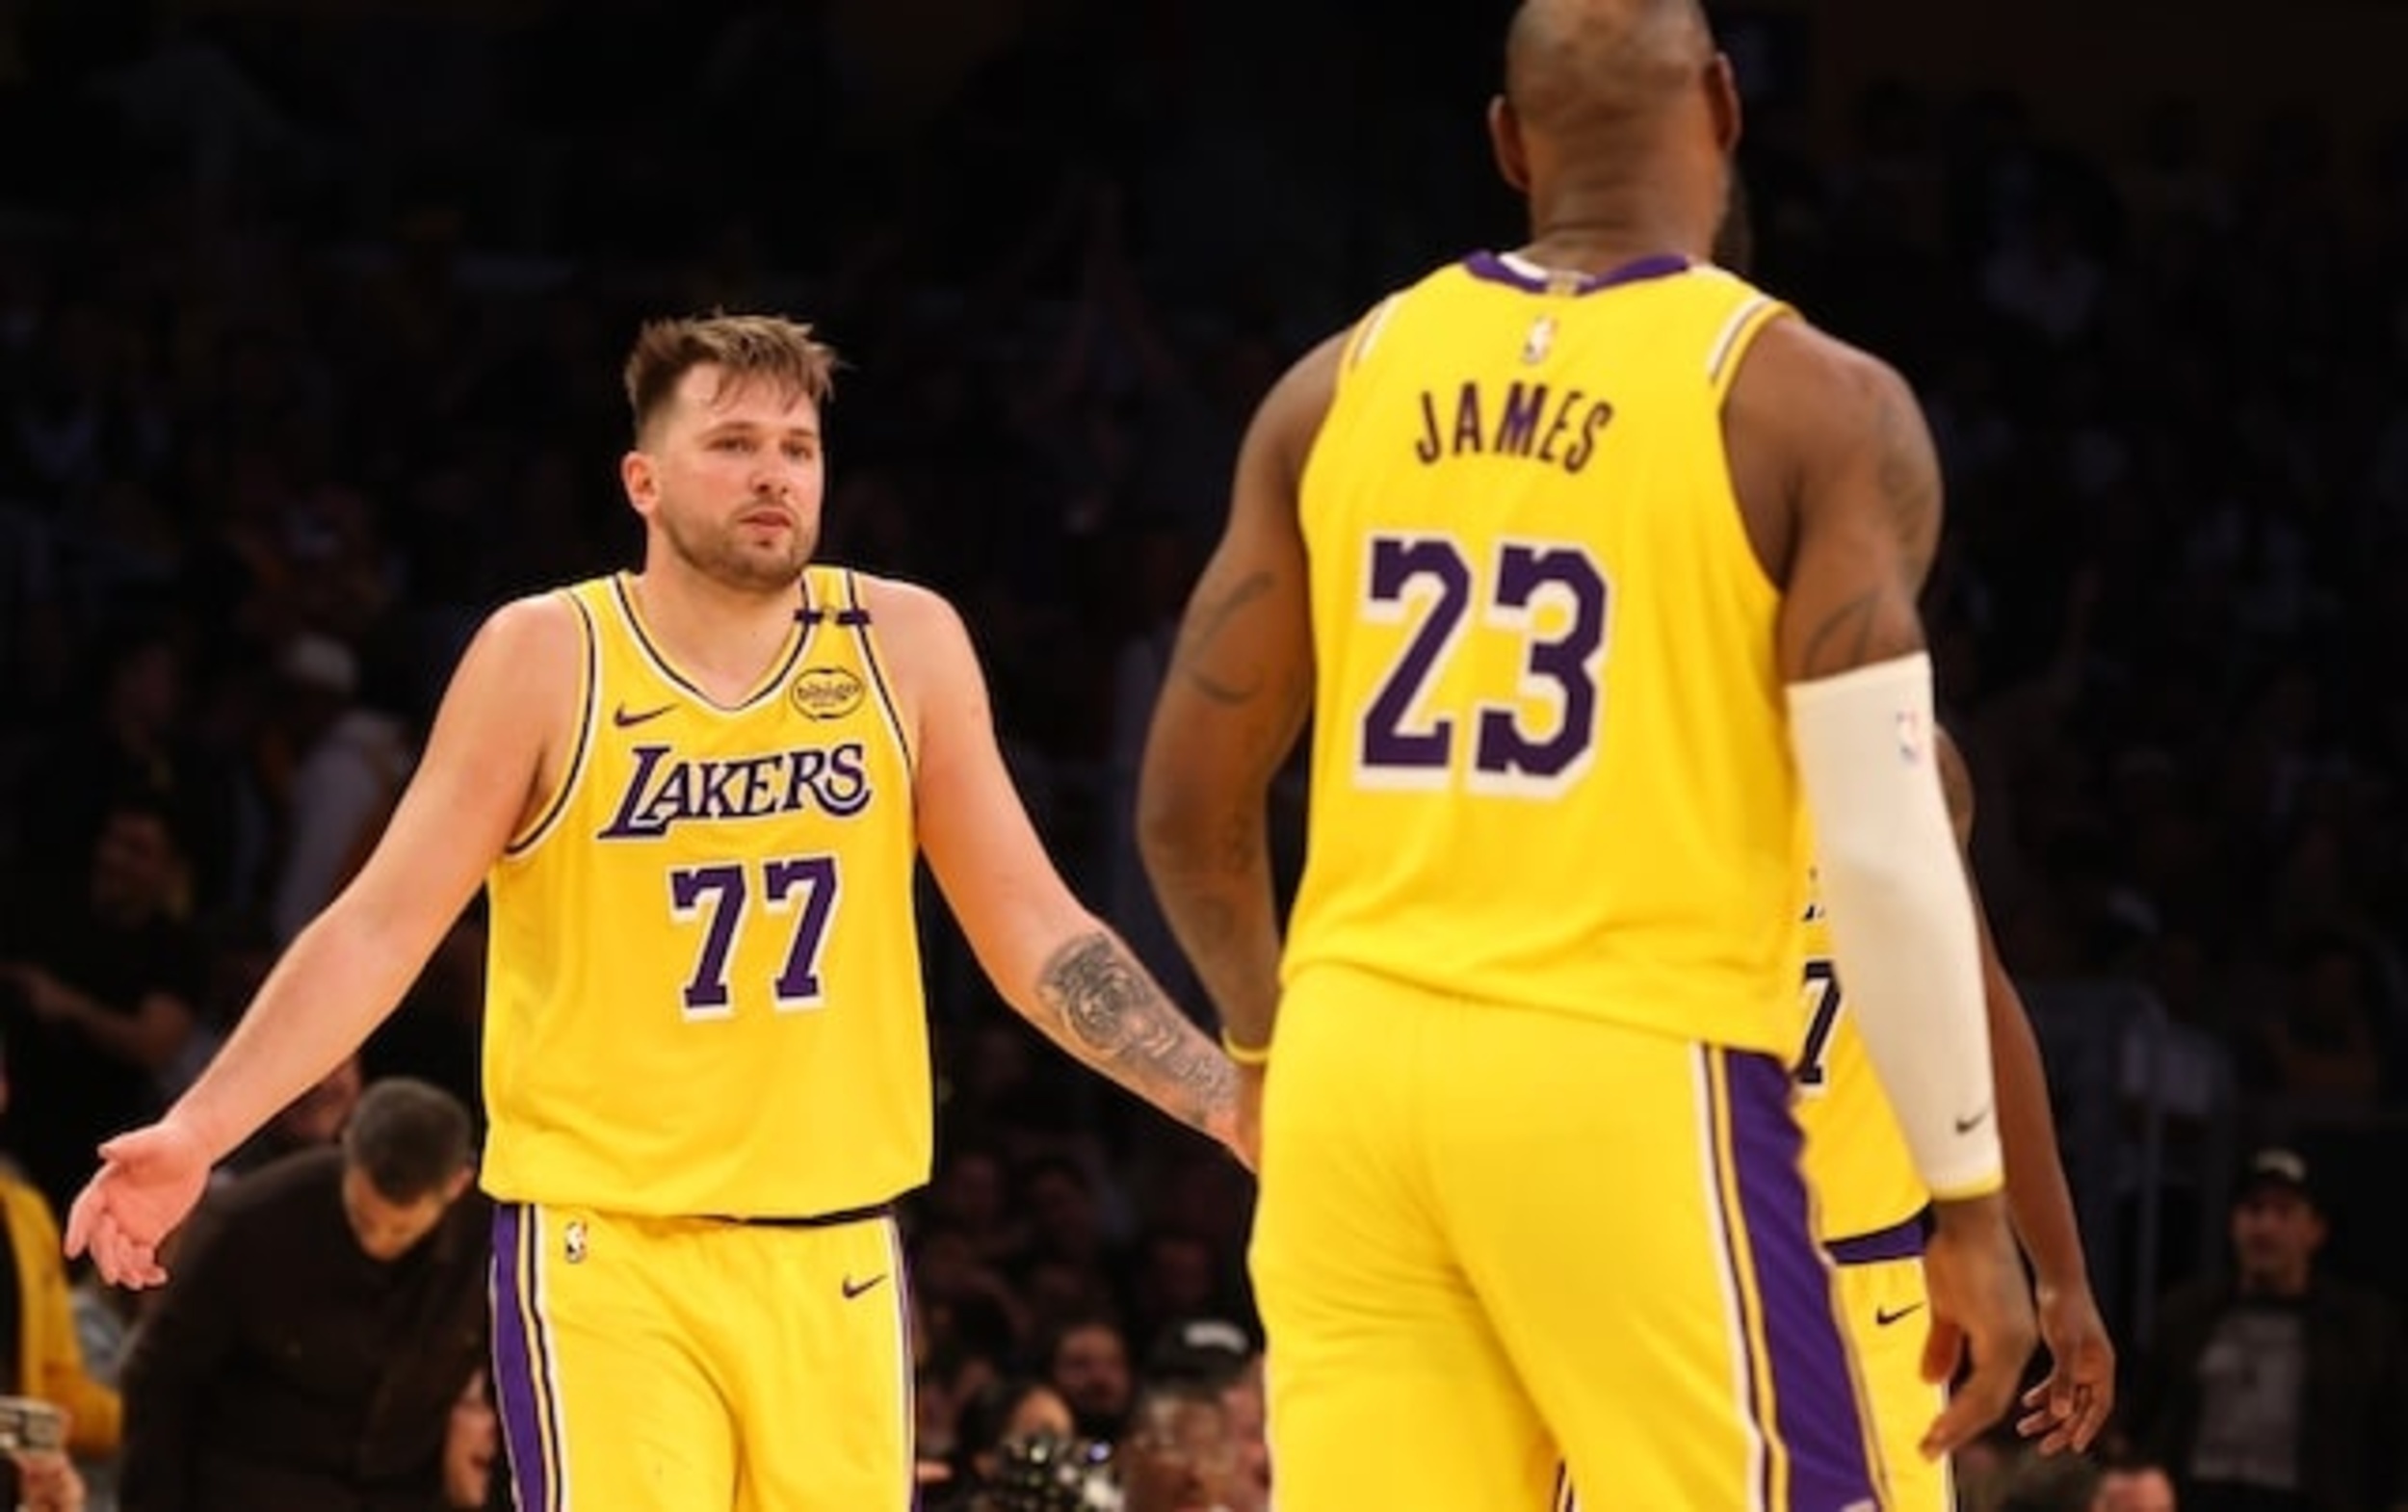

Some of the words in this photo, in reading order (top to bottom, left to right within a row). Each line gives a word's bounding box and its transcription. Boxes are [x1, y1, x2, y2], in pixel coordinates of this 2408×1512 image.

[1414, 379, 1614, 475] JAMES
[1357, 534, 1608, 784] 23
[596, 743, 872, 839] LAKERS
[667, 854, 838, 1012] 77
